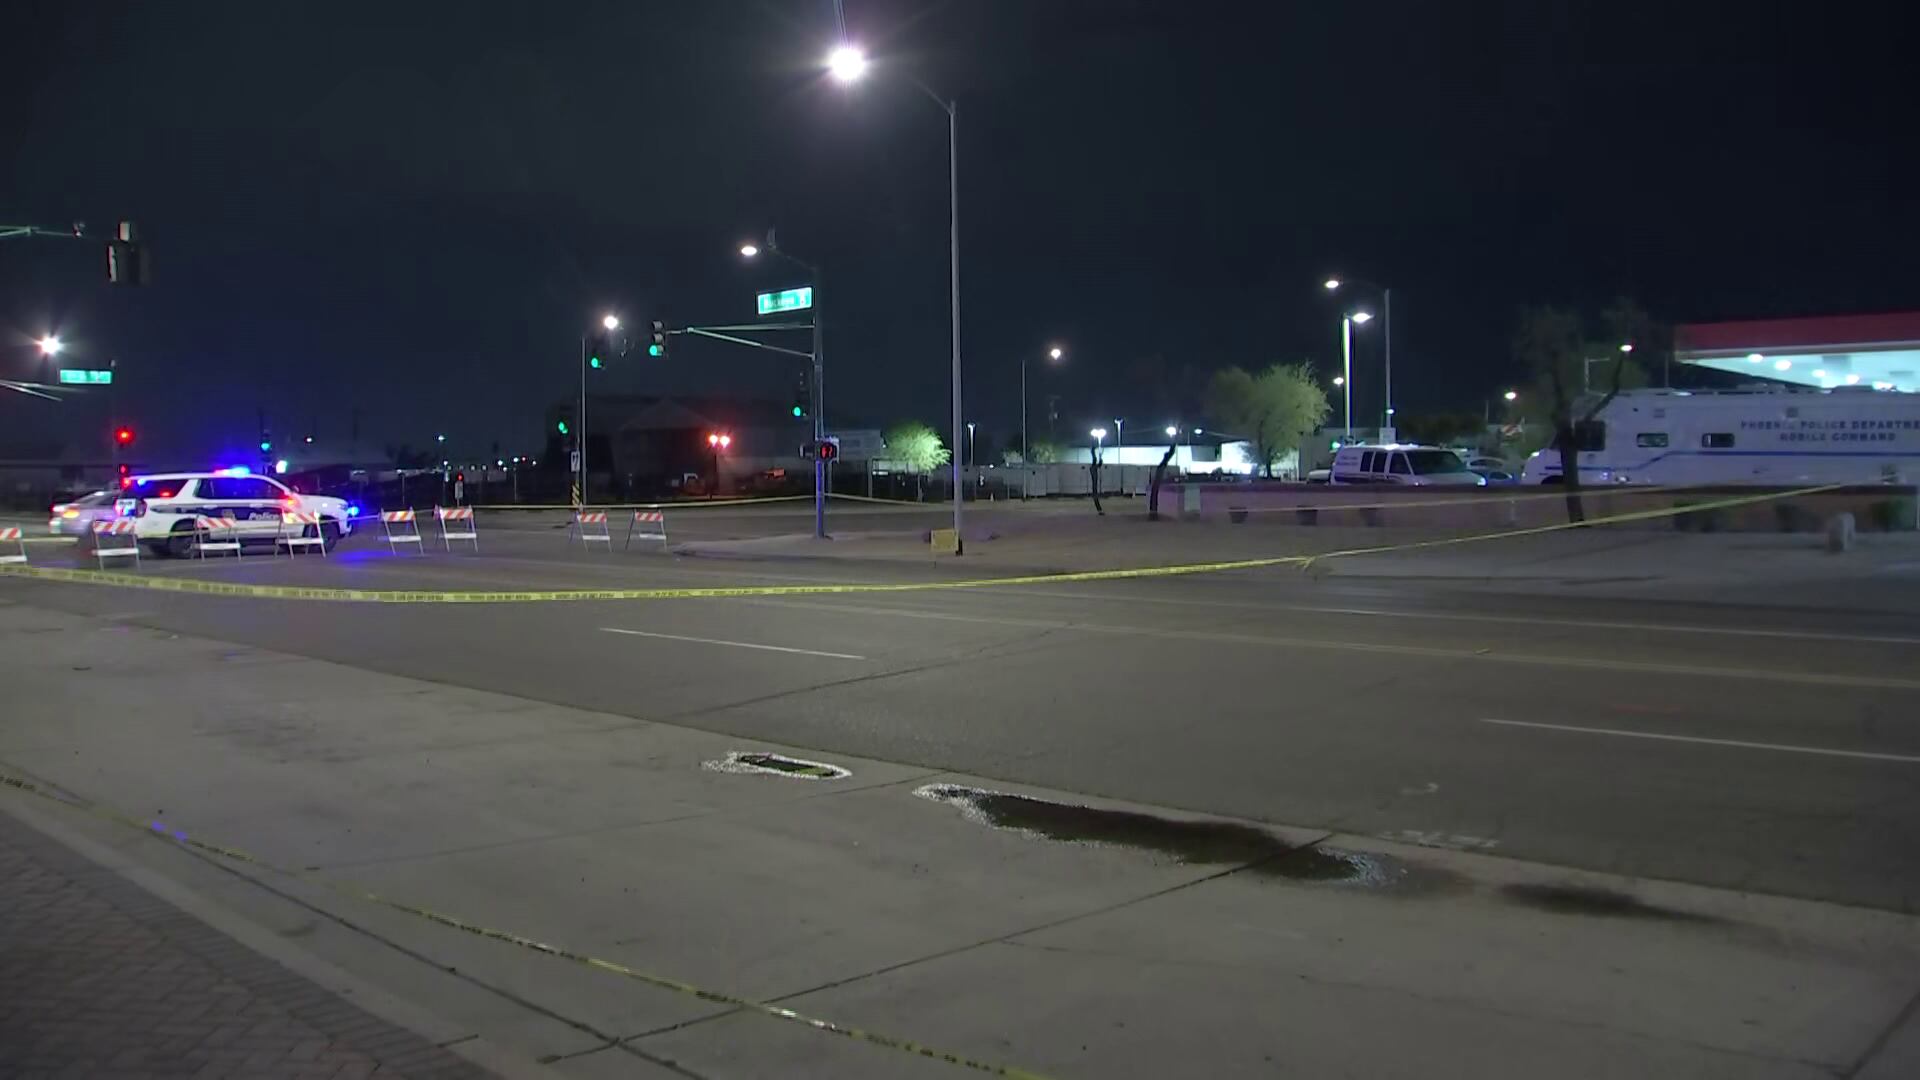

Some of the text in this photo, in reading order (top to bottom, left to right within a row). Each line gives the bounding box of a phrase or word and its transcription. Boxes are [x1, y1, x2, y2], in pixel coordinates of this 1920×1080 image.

[1800, 420, 1846, 430] POLICE
[1780, 432, 1896, 441] MOBILE COMMAND
[248, 511, 280, 521] Police
